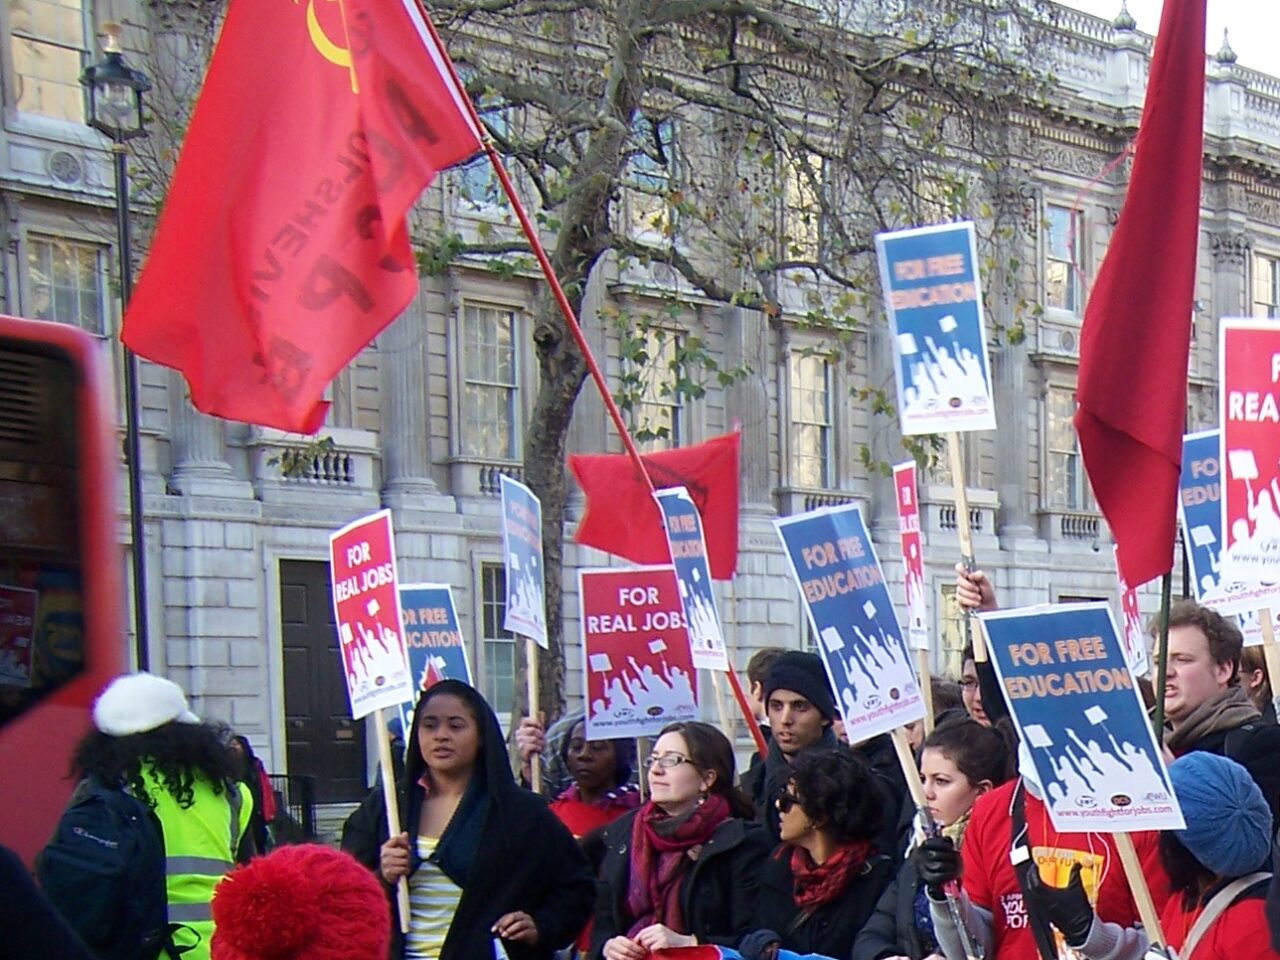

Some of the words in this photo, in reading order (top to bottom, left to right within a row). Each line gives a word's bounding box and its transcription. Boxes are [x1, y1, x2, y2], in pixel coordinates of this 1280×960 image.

[1191, 457, 1219, 479] FO
[347, 541, 371, 568] FOR
[802, 542, 838, 570] FOR
[837, 536, 866, 560] FREE
[336, 575, 360, 602] REAL
[361, 563, 394, 592] JOBS
[802, 565, 883, 604] EDUCATION
[619, 587, 660, 606] FOR
[402, 610, 417, 626] OR
[420, 608, 448, 625] FREE
[588, 614, 637, 634] REAL
[406, 631, 461, 648] UCATION
[1008, 643, 1054, 667] FOR
[1054, 636, 1108, 662] FREE
[1004, 667, 1134, 699] EDUCATION
[1002, 901, 1027, 914] YOU
